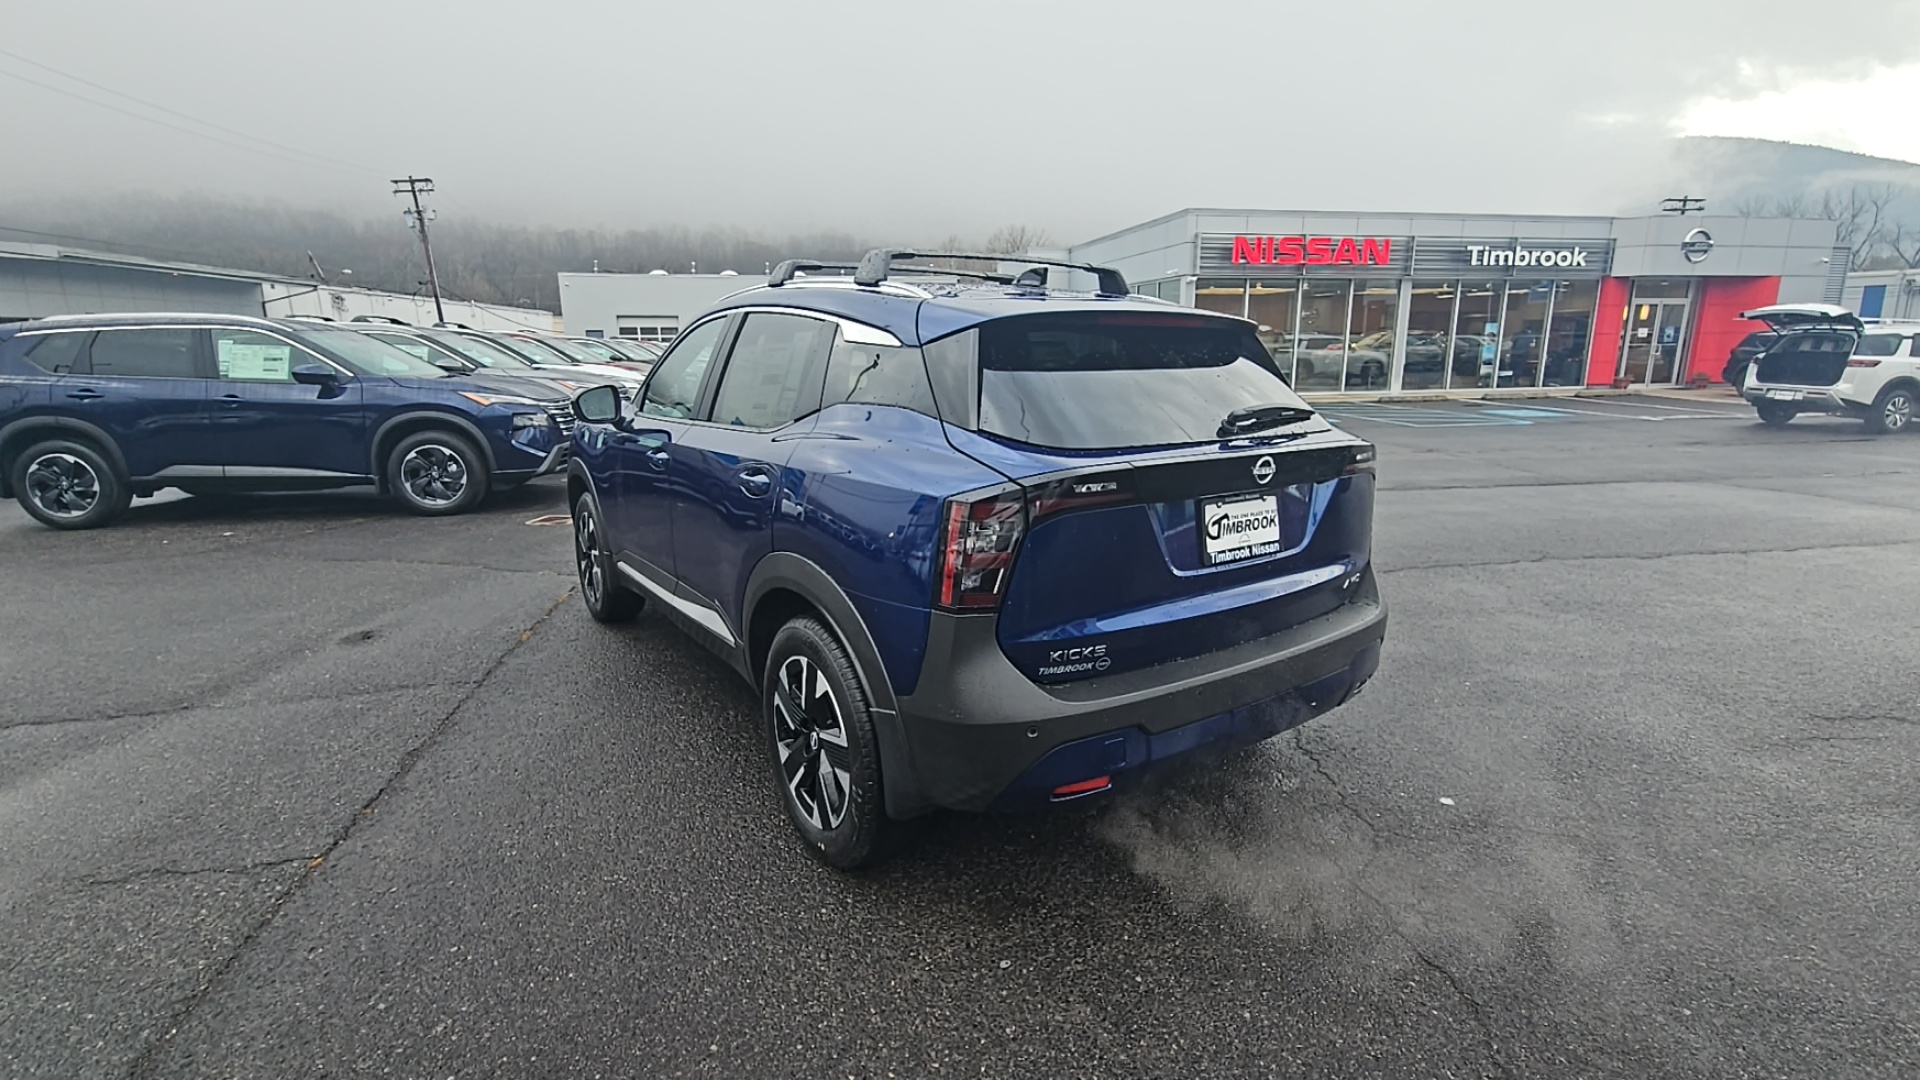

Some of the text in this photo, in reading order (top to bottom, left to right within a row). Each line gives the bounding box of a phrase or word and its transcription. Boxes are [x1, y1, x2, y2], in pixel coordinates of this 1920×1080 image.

[1232, 236, 1391, 266] NISSAN
[1467, 245, 1588, 268] Timbrook
[1207, 512, 1278, 540] TIMBROOK
[1210, 542, 1280, 564] Timbrook Nissan
[1049, 644, 1107, 662] KICKS
[1038, 662, 1095, 675] TIMBROOK
